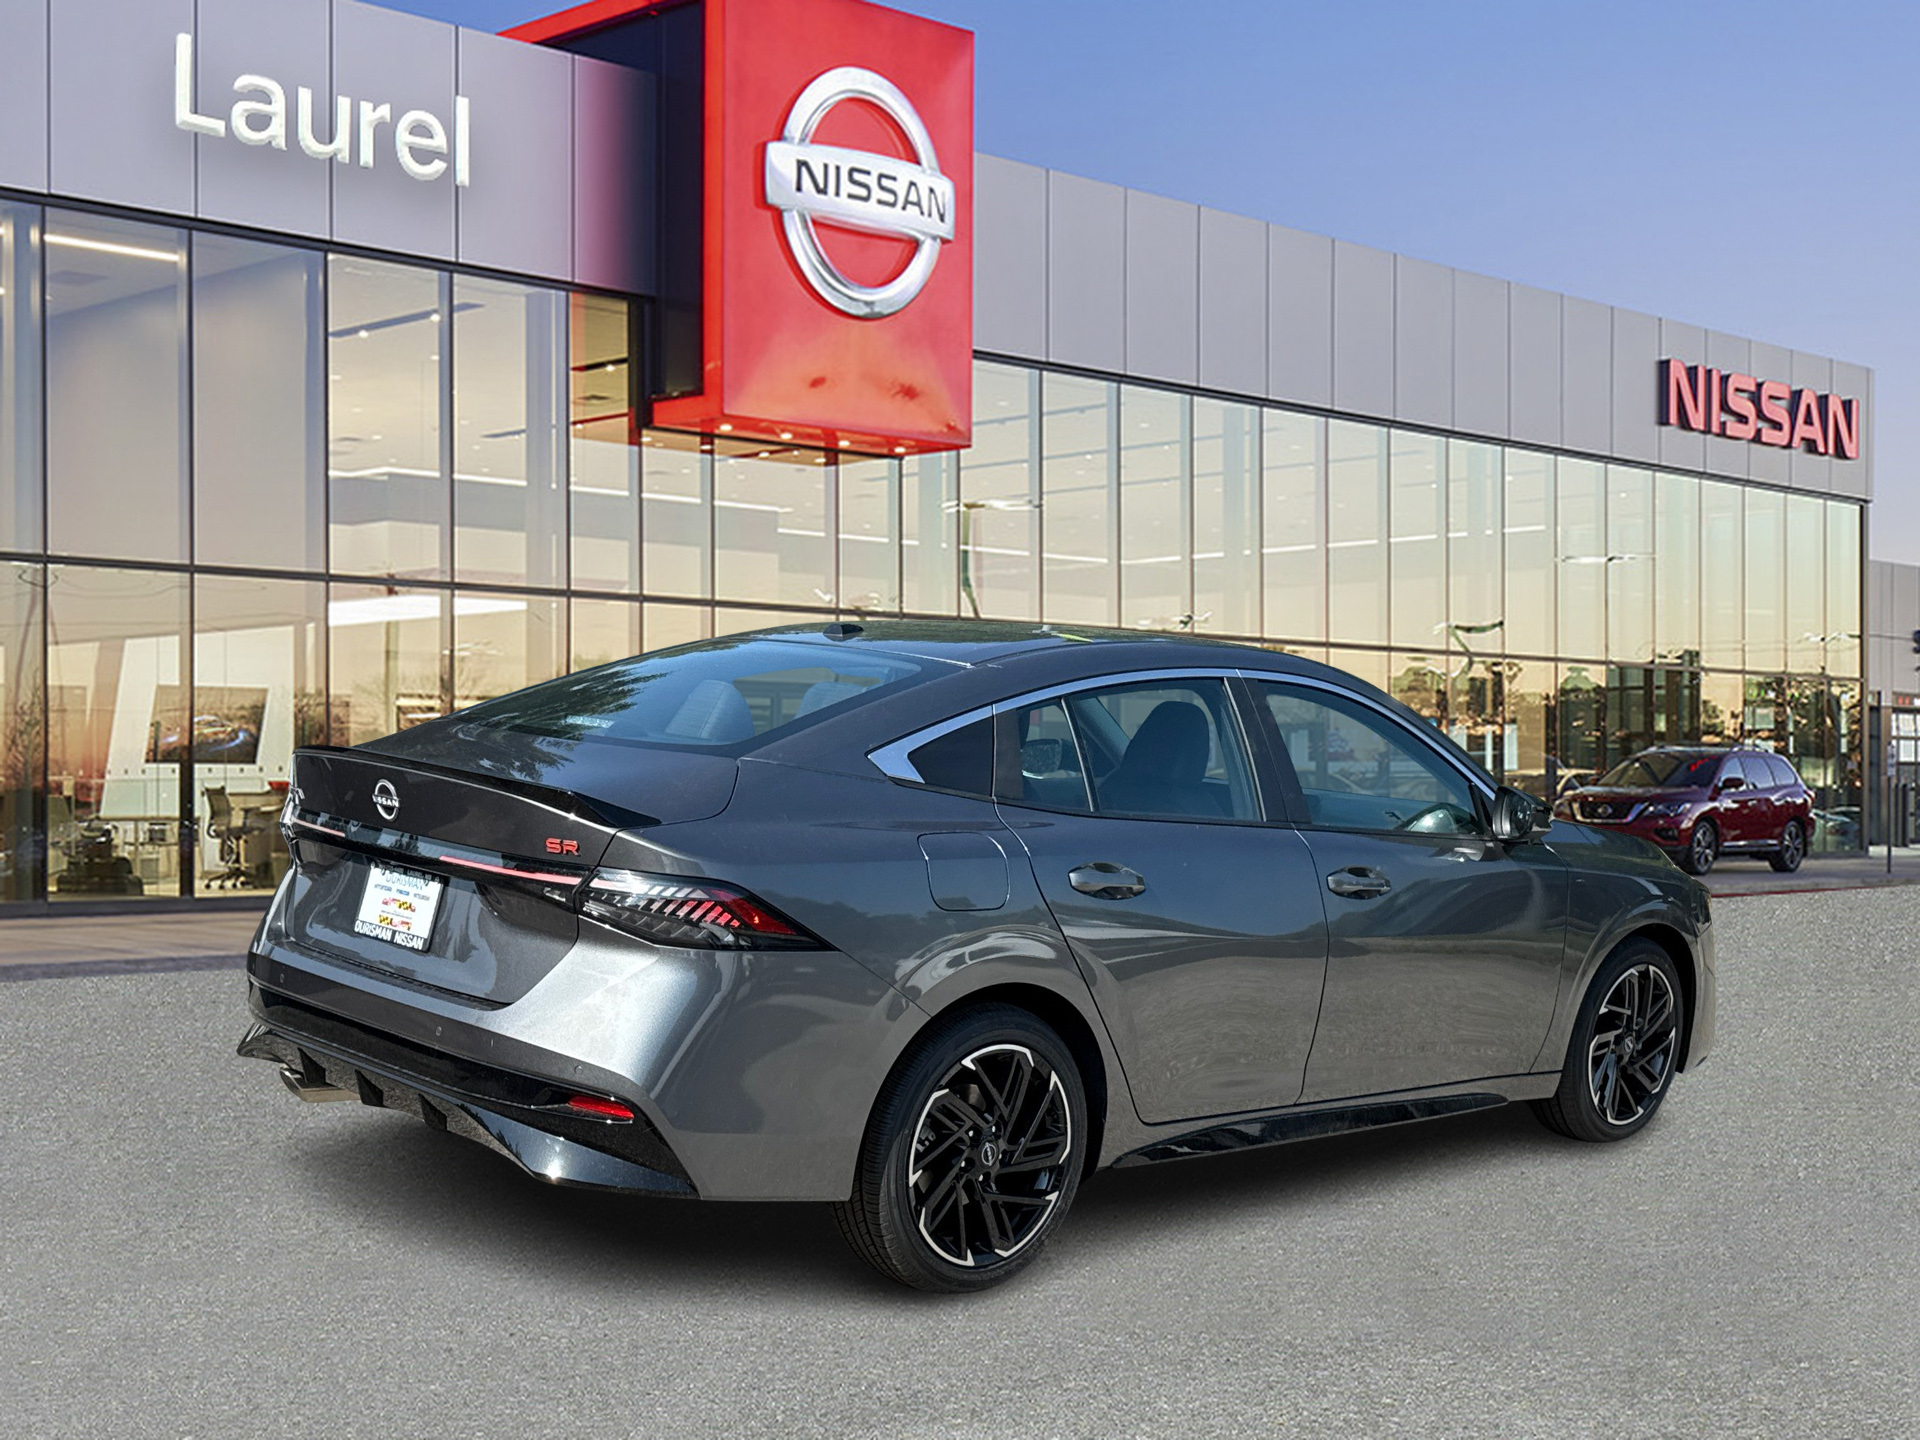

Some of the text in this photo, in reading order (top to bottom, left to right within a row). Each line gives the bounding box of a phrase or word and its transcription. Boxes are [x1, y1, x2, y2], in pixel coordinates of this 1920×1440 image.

[175, 33, 470, 188] Laurel
[795, 159, 946, 223] NISSAN
[1666, 358, 1860, 460] NISSAN
[373, 794, 399, 805] SSAN
[545, 837, 579, 856] SR
[354, 920, 424, 950] OURISMAN NISSAN
